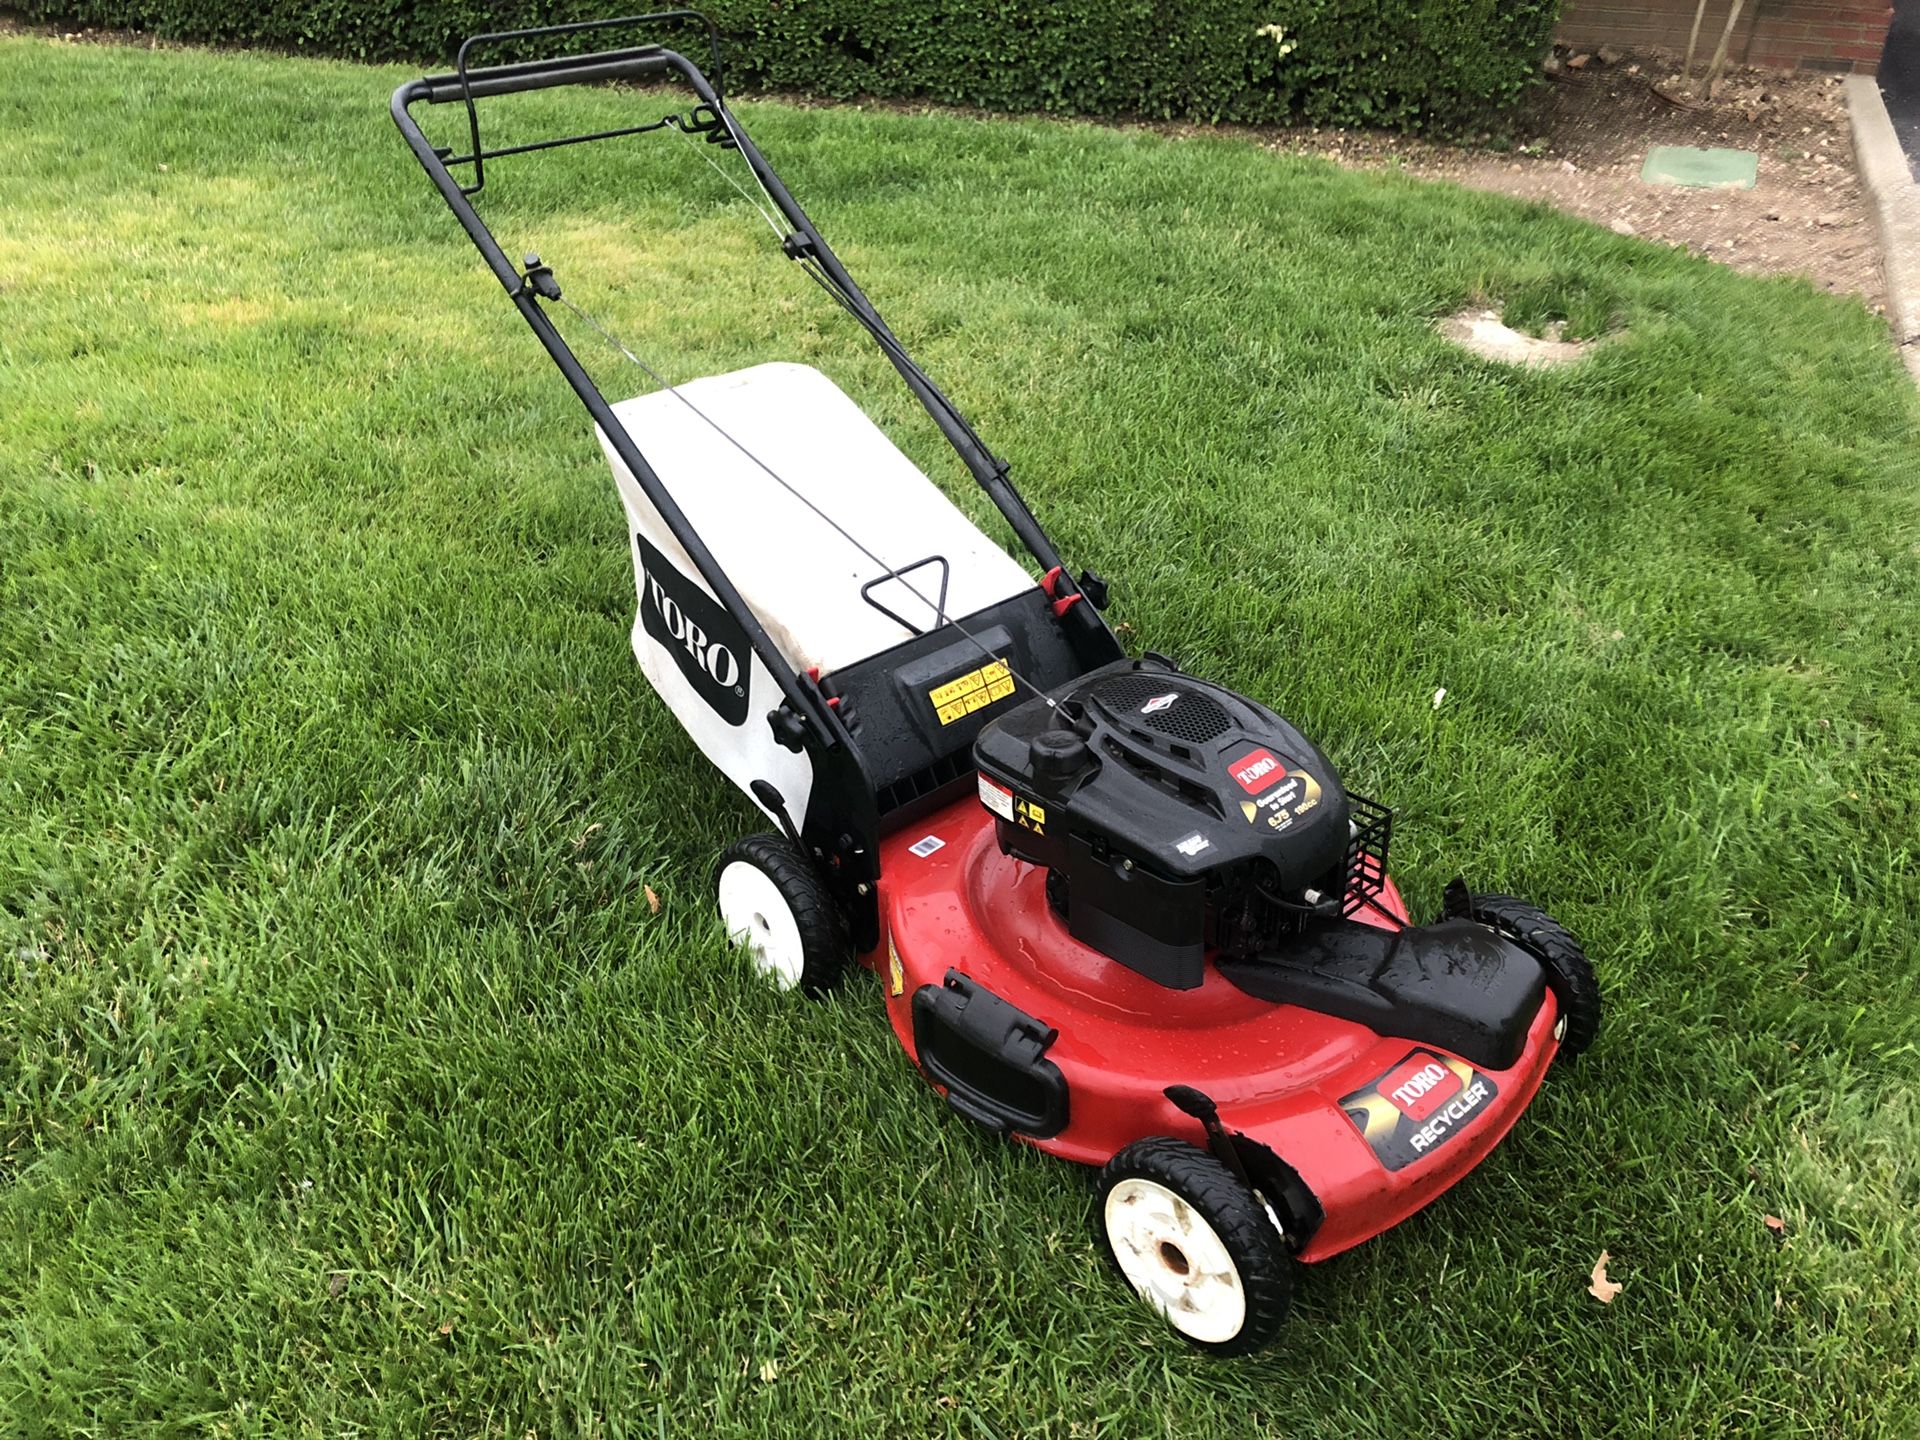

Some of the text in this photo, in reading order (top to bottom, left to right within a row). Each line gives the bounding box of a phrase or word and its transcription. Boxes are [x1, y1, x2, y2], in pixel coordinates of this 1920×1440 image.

[1236, 757, 1278, 785] TORO
[1277, 791, 1297, 806] Start
[1267, 809, 1290, 827] 6.75
[1294, 799, 1318, 815] 190cc
[1392, 1063, 1446, 1107] TORO
[1409, 1082, 1489, 1153] RECYCLER
